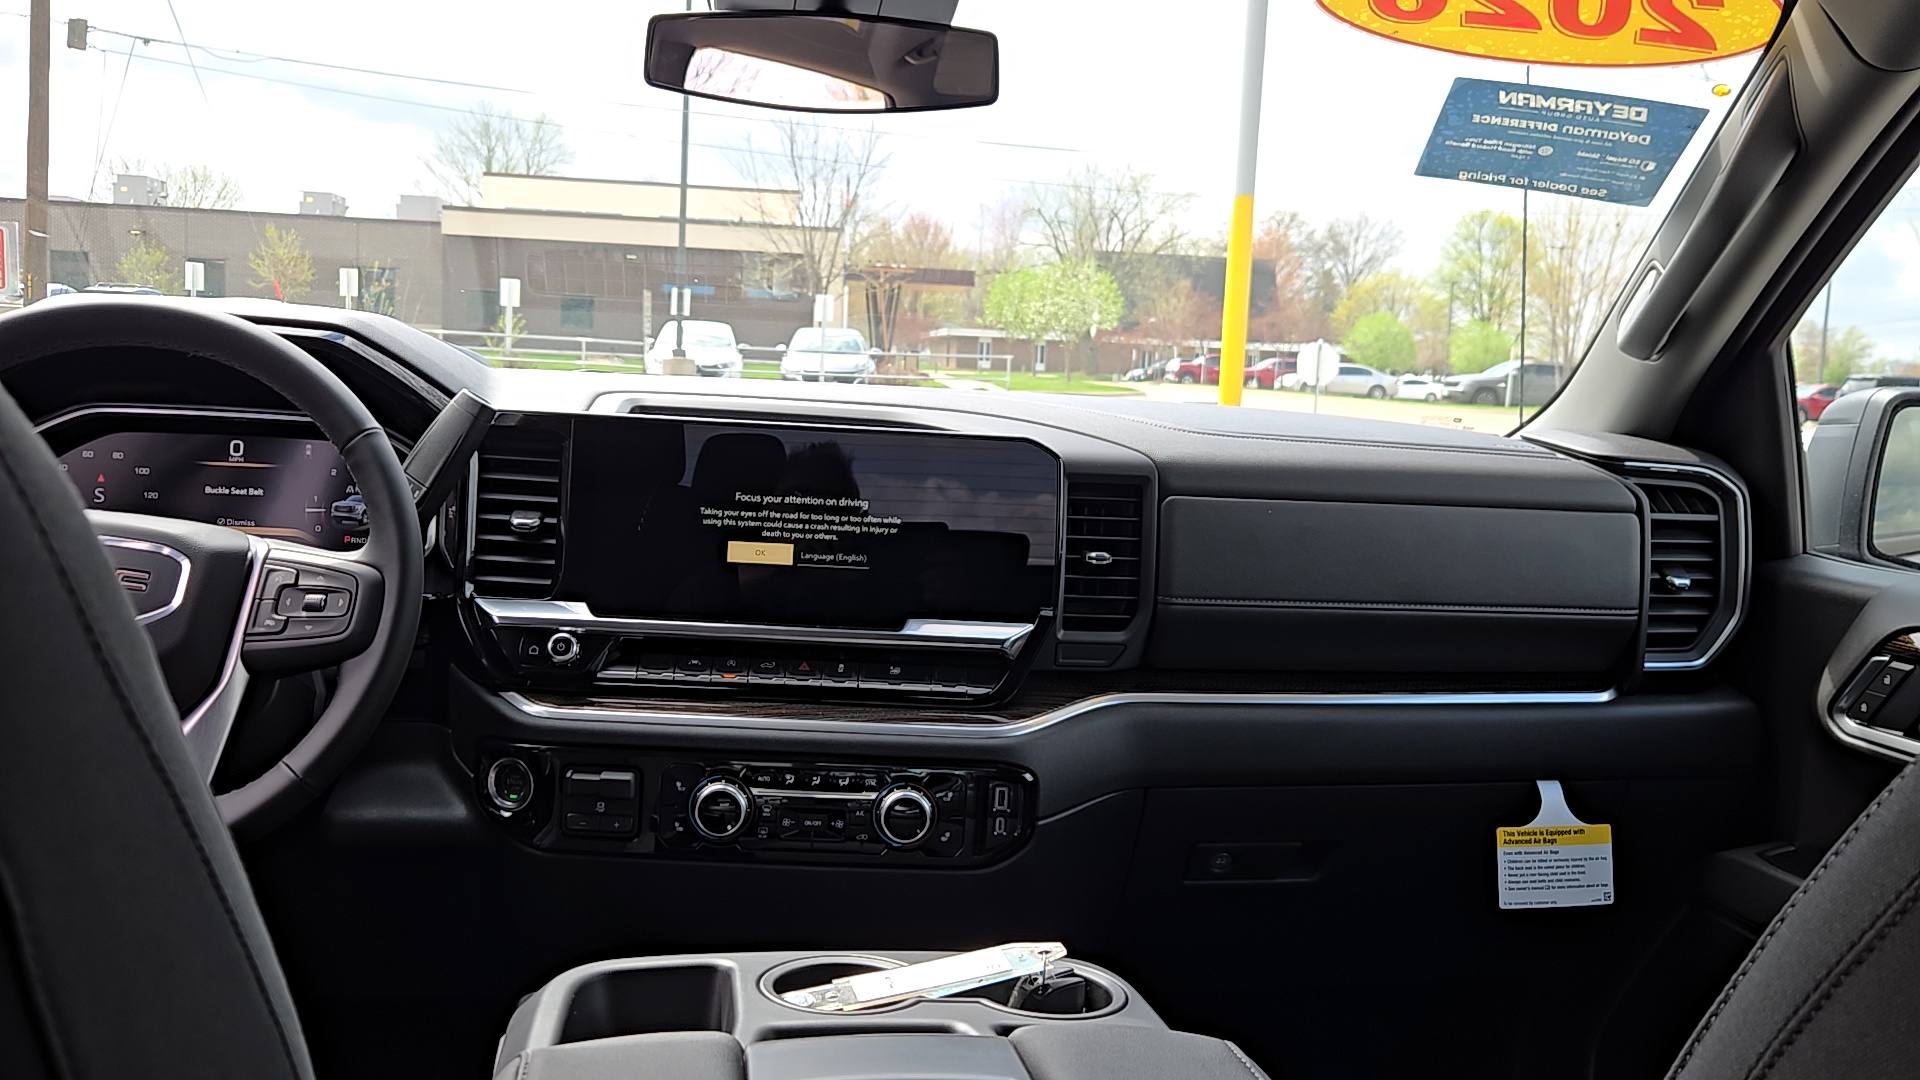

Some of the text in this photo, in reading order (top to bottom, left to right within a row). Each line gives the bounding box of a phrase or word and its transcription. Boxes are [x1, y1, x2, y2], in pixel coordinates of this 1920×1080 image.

[229, 439, 244, 458] 0
[134, 467, 150, 475] 100
[92, 487, 105, 504] S
[143, 491, 159, 500] 120
[204, 486, 264, 497] Buckle Seat Belt
[735, 491, 869, 510] Focus your attention on driving
[700, 507, 722, 517] Taking
[723, 508, 739, 518] your
[740, 509, 756, 518] eyes
[758, 508, 769, 518] off
[770, 510, 781, 519] the
[782, 510, 798, 519] road
[799, 511, 810, 520] for
[824, 513, 840, 523] long
[863, 514, 882, 523] often
[883, 516, 902, 524] while
[226, 517, 256, 527] Dismiss
[703, 518, 722, 527] using
[737, 519, 762, 530] system
[763, 520, 782, 528] could
[810, 522, 829, 531] crash
[830, 522, 860, 534] resulting
[869, 525, 888, 535] injury
[762, 529, 782, 538] death
[814, 532, 838, 541] others.
[755, 549, 766, 558] OK
[800, 551, 867, 563] Language (English)
